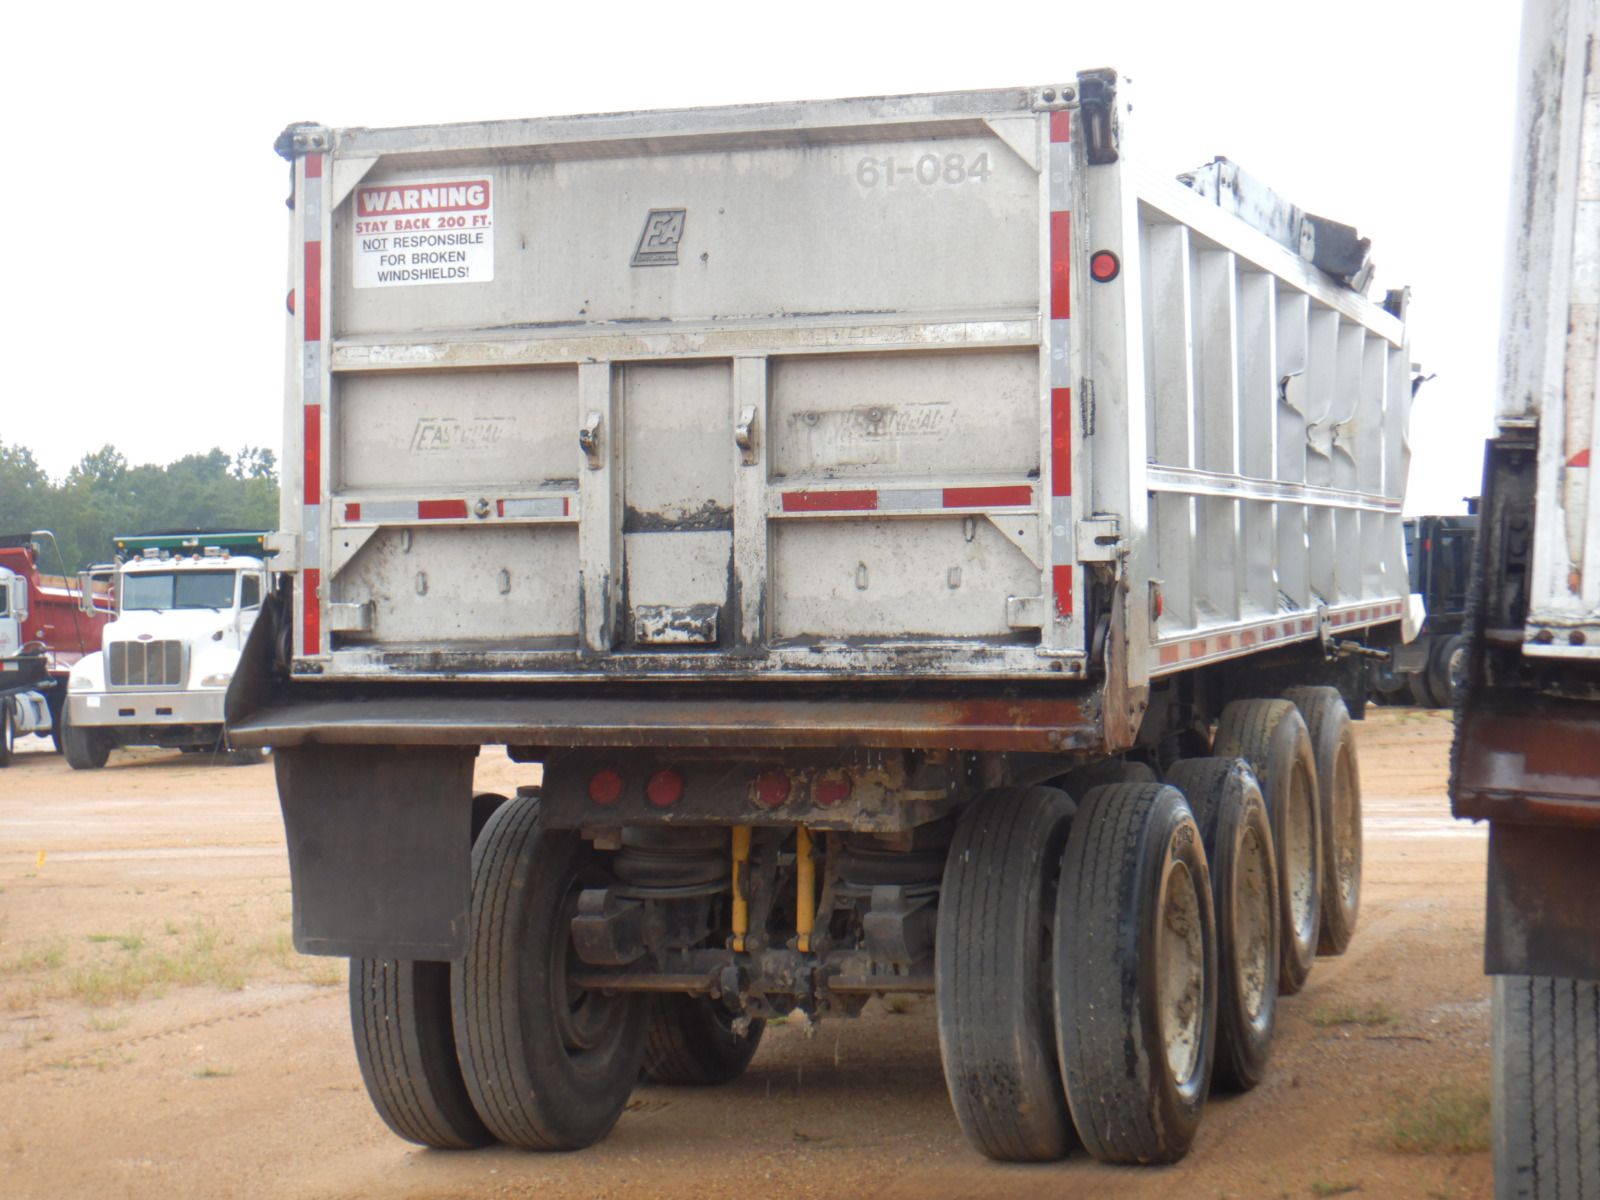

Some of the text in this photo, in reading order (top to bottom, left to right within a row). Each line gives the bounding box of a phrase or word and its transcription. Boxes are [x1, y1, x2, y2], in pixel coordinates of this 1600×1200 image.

[856, 152, 992, 188] 61-084
[361, 184, 486, 213] WARNING
[355, 214, 492, 234] STAY BACK 200 FT.
[362, 232, 484, 251] NOT RESPONSIBLE
[379, 251, 466, 266] FOR BROKEN
[377, 266, 470, 282] WINDSHIELDS!
